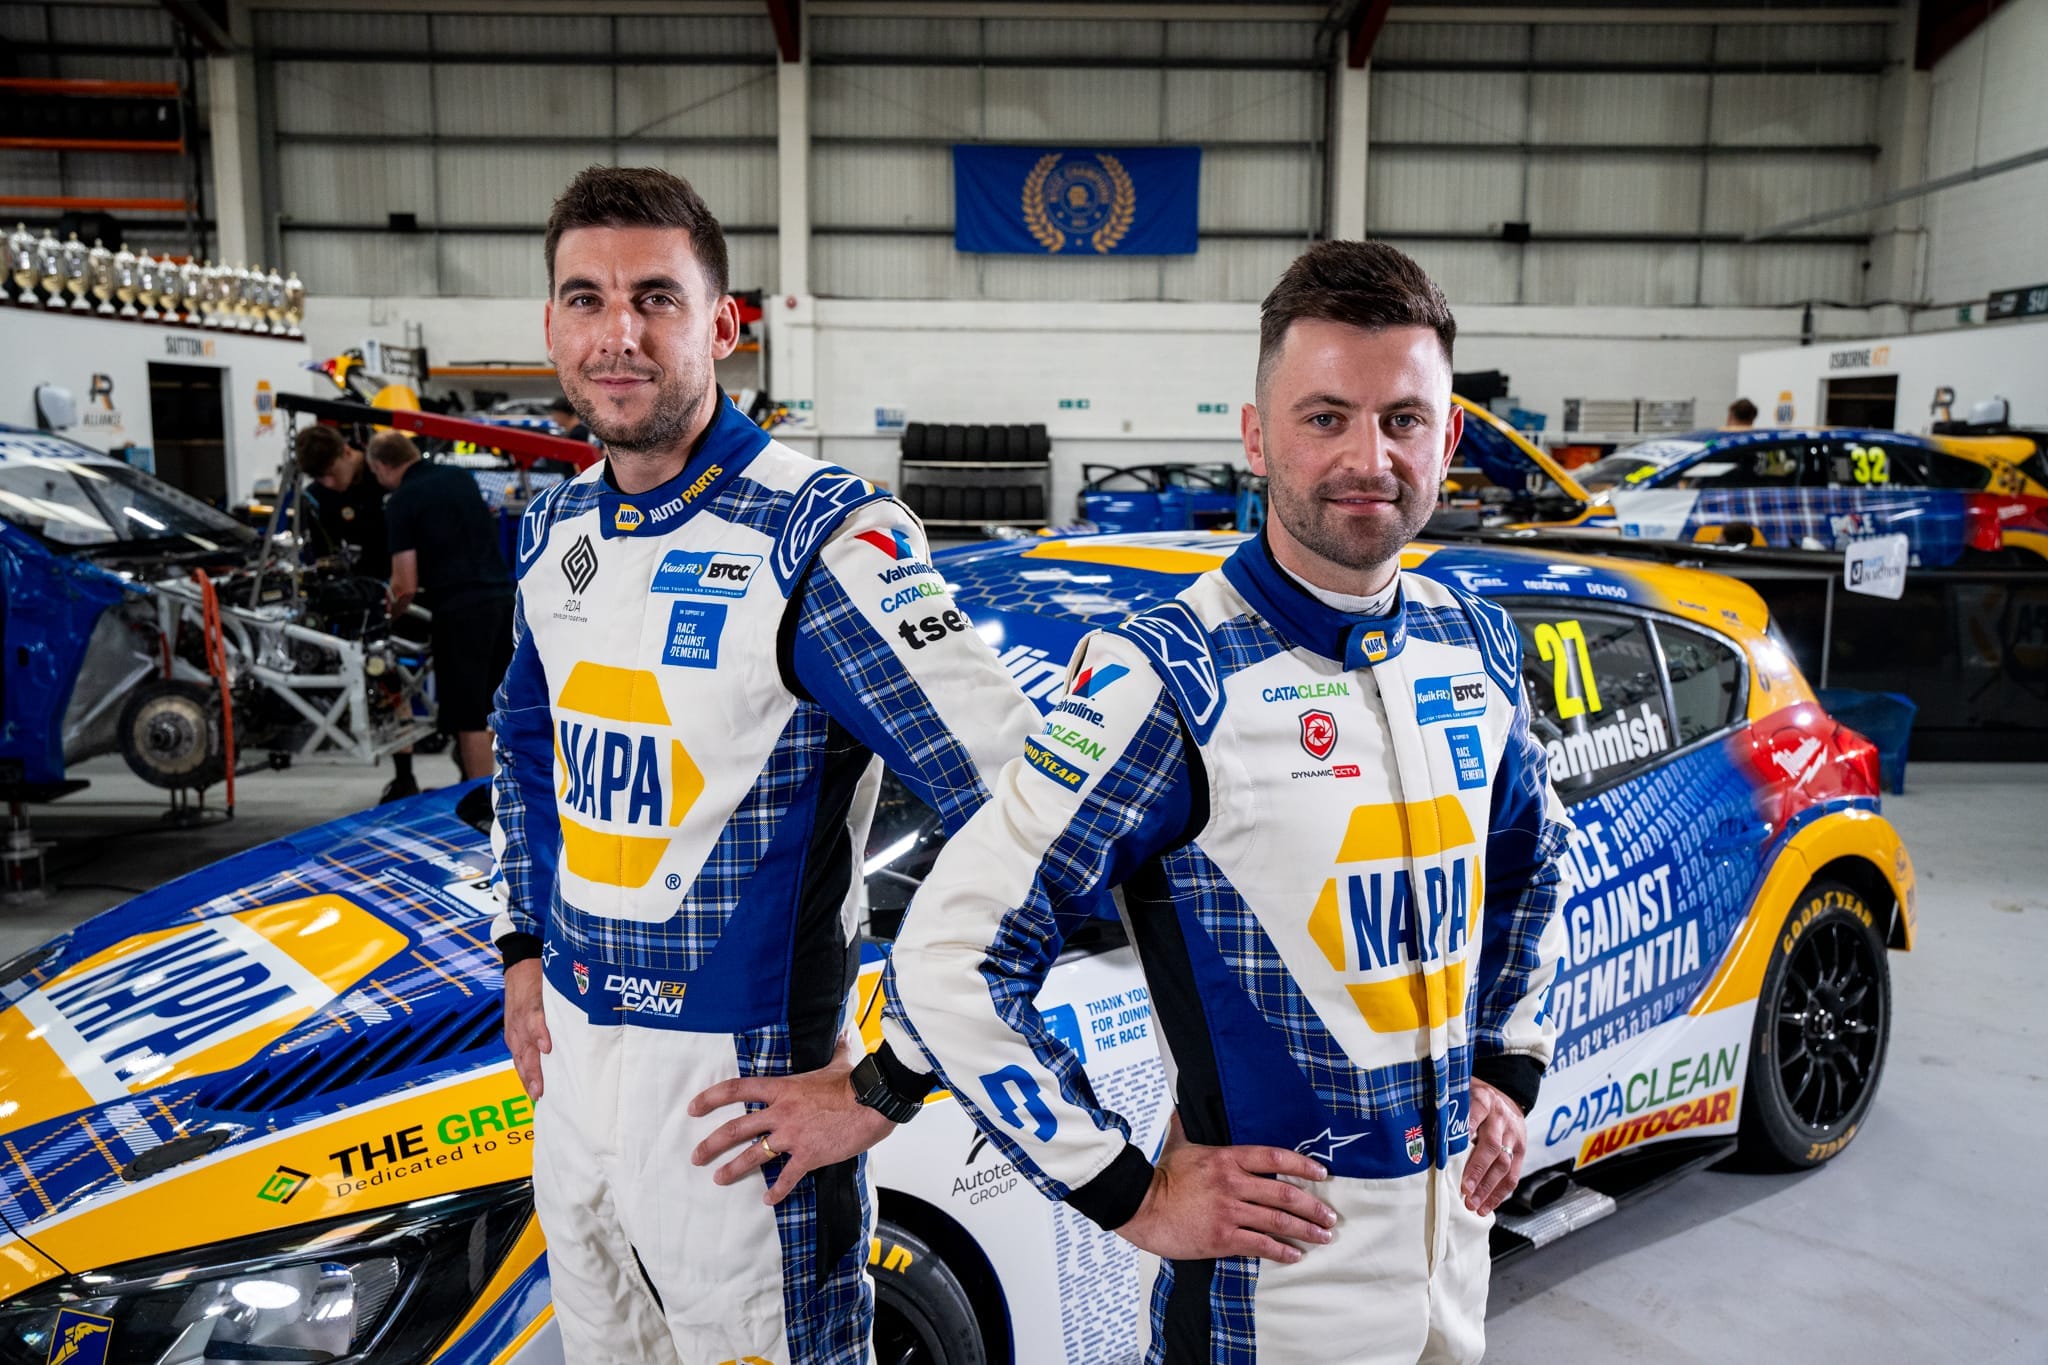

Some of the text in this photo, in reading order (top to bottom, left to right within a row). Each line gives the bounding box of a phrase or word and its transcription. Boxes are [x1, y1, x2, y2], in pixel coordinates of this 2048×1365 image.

[166, 336, 201, 356] SUTTON
[1851, 447, 1889, 483] 32
[619, 464, 723, 524] NAPA AUTO PARTS
[707, 563, 751, 581] BTCC
[1586, 582, 1628, 599] DENSO
[673, 634, 706, 647] AGAINST
[676, 622, 697, 634] RACE
[898, 610, 967, 650] tse
[670, 646, 710, 660] DEMENTIA
[1534, 620, 1602, 720] 27
[1262, 683, 1348, 703] CATACLEAN
[1453, 683, 1485, 701] BTCC
[1547, 703, 1668, 783] ammish
[560, 720, 663, 827] NAPA
[1292, 767, 1358, 779] DYNAMIC CCTV
[1566, 821, 1620, 899] ACE
[1348, 858, 1467, 971] NAPA
[604, 974, 685, 996] DAN 27
[1552, 919, 1700, 1039] DEMENTIA
[46, 928, 297, 1082] NAPA
[622, 992, 683, 1015] CAM
[1085, 987, 1148, 1016] THANK YOU
[1091, 1004, 1151, 1034] FOR JOININ
[1095, 1024, 1147, 1052] THE RACE
[1545, 1043, 1740, 1147] CATACLEAN
[329, 1095, 536, 1178] THE GRE
[1582, 1090, 1731, 1165] AUTOCAR
[337, 1130, 535, 1197] Dedicated to Se
[969, 1178, 1018, 1205] GROUP
